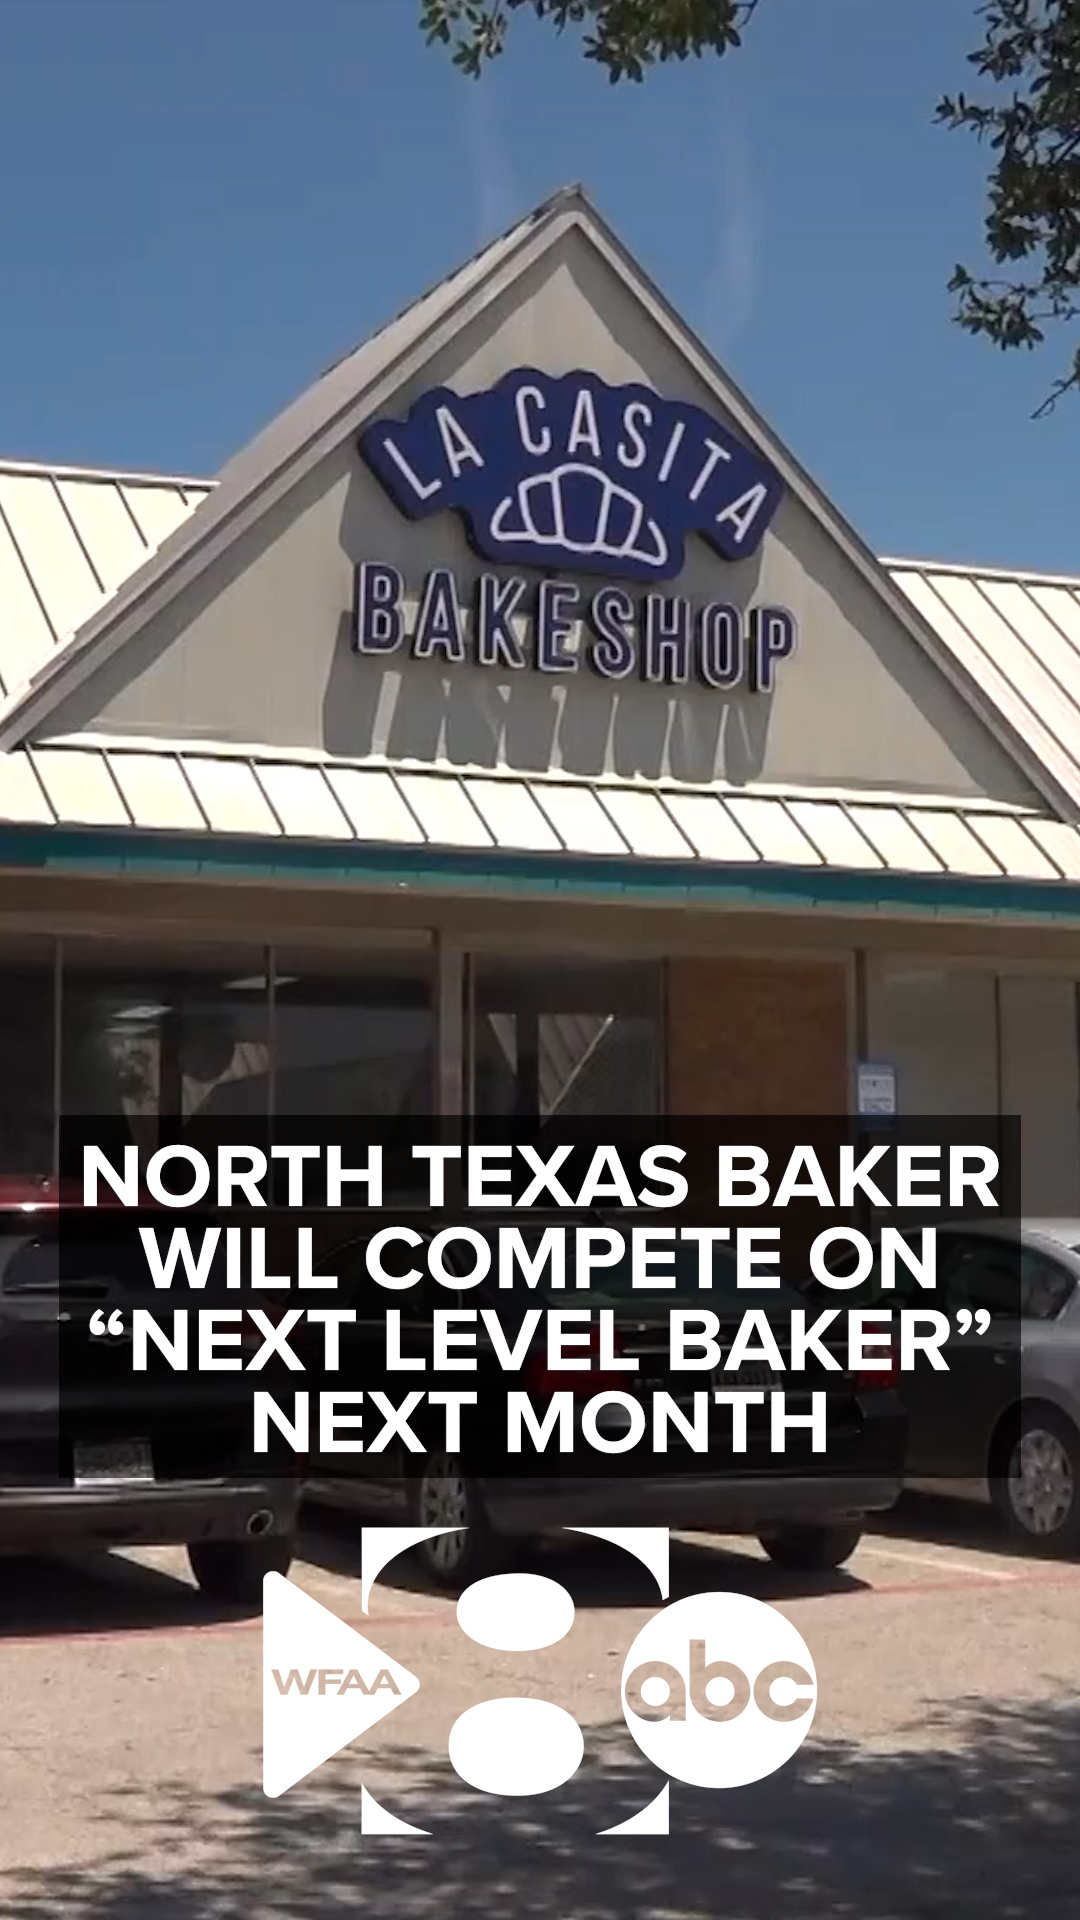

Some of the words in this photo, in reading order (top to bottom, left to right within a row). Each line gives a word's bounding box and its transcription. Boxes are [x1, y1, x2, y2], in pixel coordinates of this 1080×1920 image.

[383, 404, 485, 501] LA
[515, 385, 767, 543] CASITA
[355, 561, 797, 694] BAKESHOP
